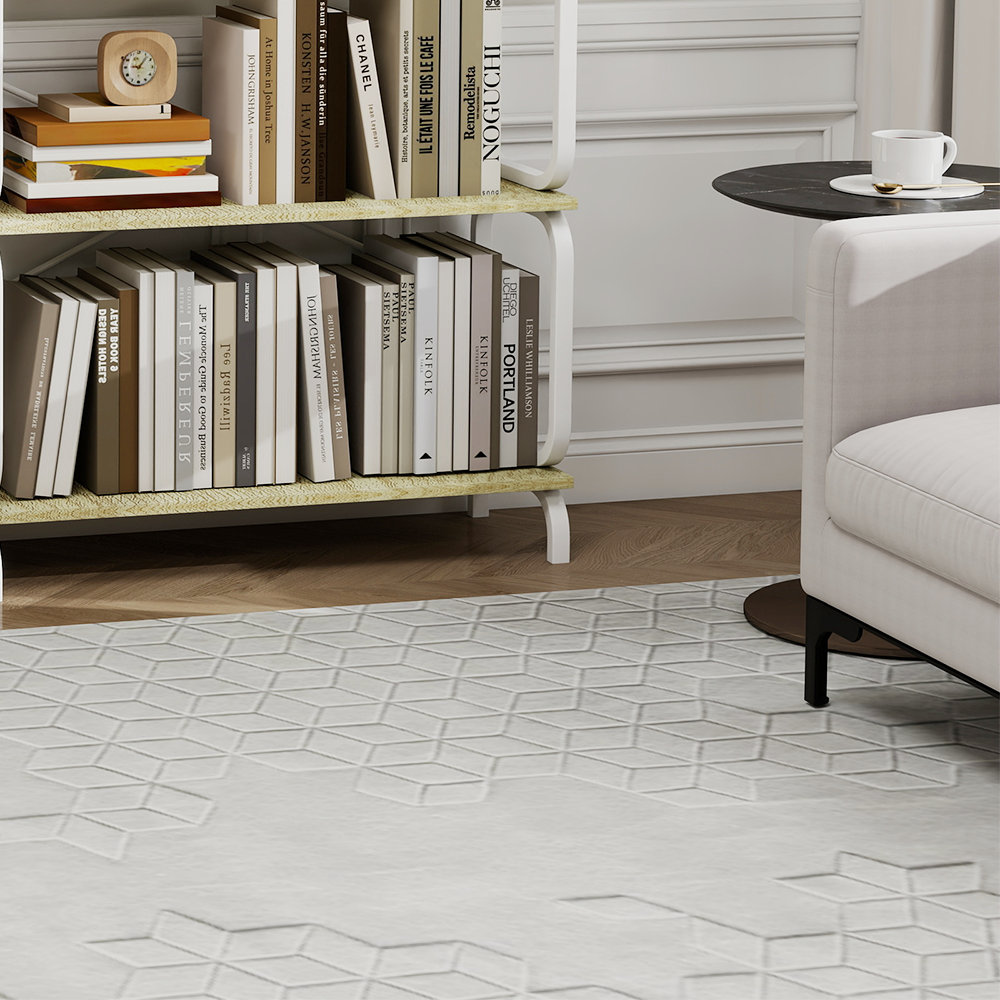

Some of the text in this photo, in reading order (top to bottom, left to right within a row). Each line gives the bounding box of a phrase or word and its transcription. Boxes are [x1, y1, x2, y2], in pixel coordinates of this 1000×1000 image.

[355, 34, 372, 92] CHANEL
[300, 32, 312, 185] KONSTEN H.W.JANSON
[463, 66, 476, 140] Remodelista
[482, 45, 501, 161] NOGUCHI
[391, 292, 399, 322] PAUL
[502, 277, 510, 323] UCHITEL
[509, 282, 517, 317] DIEGO
[525, 318, 534, 349] LESLIE
[424, 337, 433, 395] KINFOLK
[479, 336, 488, 394] KINFOLK
[502, 343, 517, 434] PORTLAND
